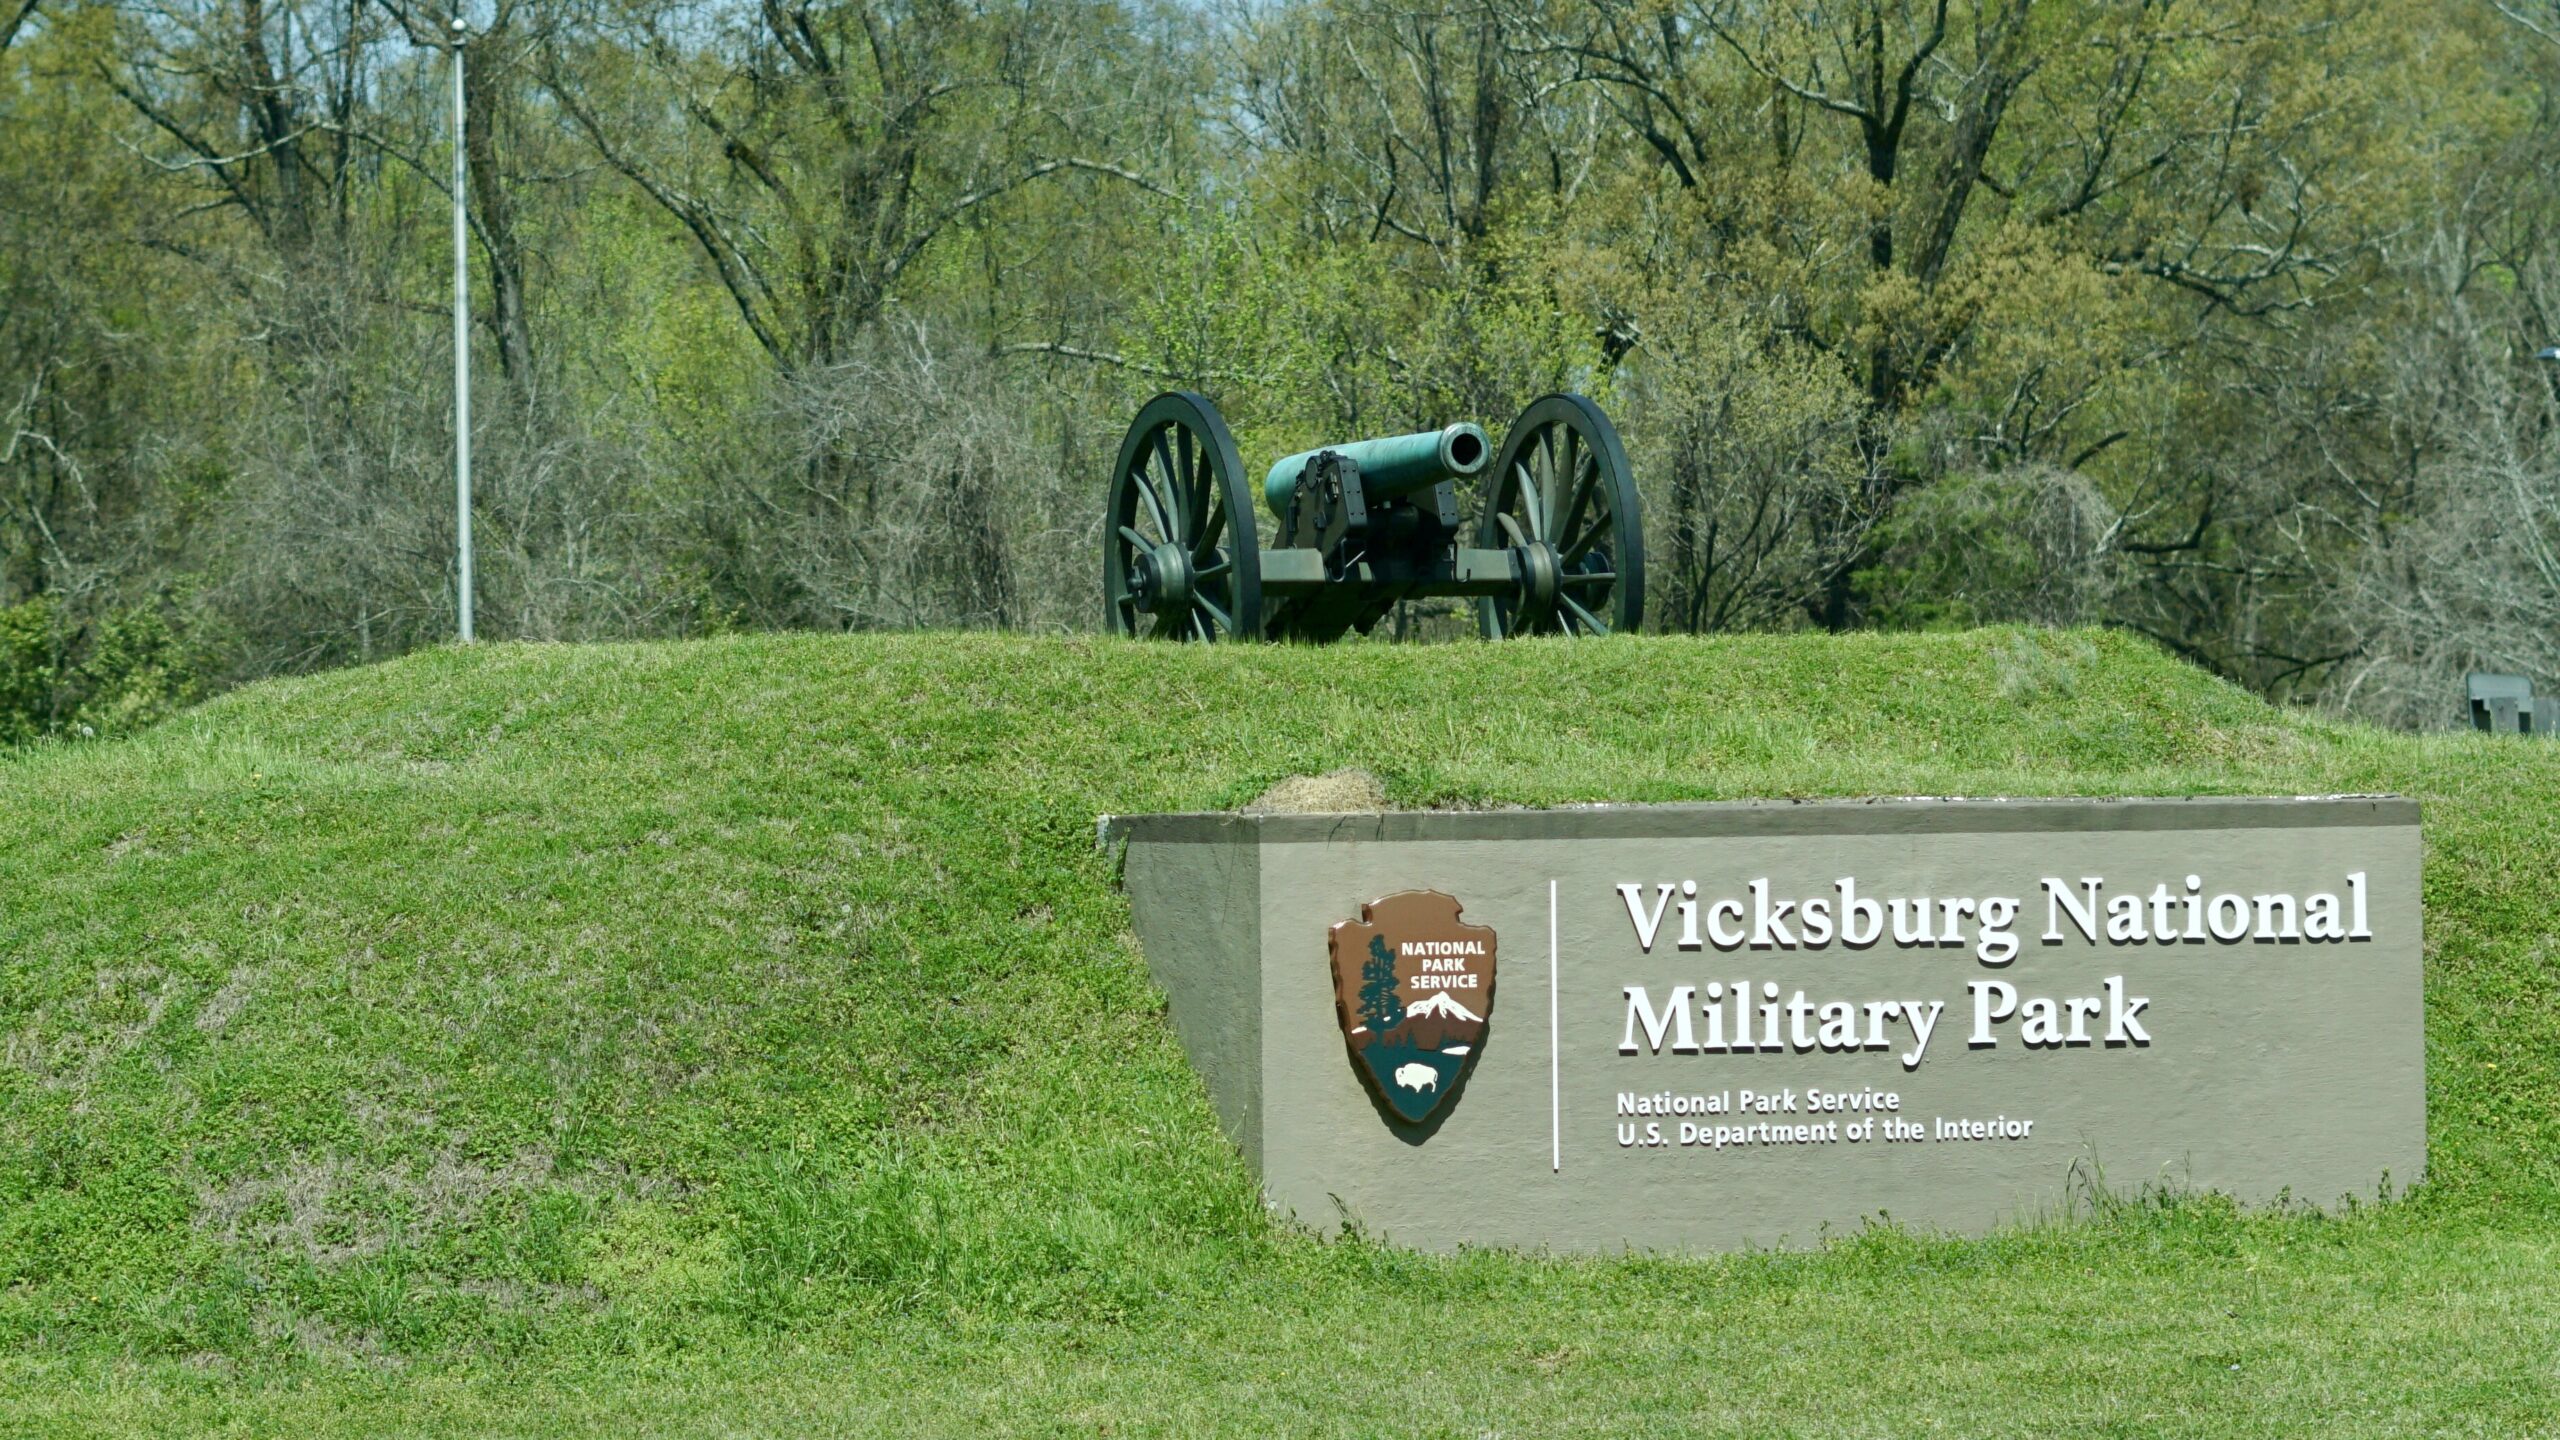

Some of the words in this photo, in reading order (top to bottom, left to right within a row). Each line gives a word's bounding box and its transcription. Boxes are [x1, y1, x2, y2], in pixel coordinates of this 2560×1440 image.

[1617, 876, 2020, 964] Vicksburg
[2041, 871, 2373, 941] National
[1401, 941, 1486, 956] NATIONAL
[1422, 958, 1465, 972] PARK
[1410, 974, 1478, 989] SERVICE
[1618, 980, 1945, 1066] Military
[1967, 974, 2152, 1047] Park
[1617, 1090, 1729, 1114] National
[1740, 1088, 1797, 1112] Park
[1806, 1086, 1900, 1111] Service
[1617, 1122, 1669, 1145] U.S.
[1680, 1120, 1838, 1149] Department
[1846, 1116, 1874, 1140] of
[1882, 1116, 1925, 1139] the
[1935, 1114, 2034, 1139] Interior
